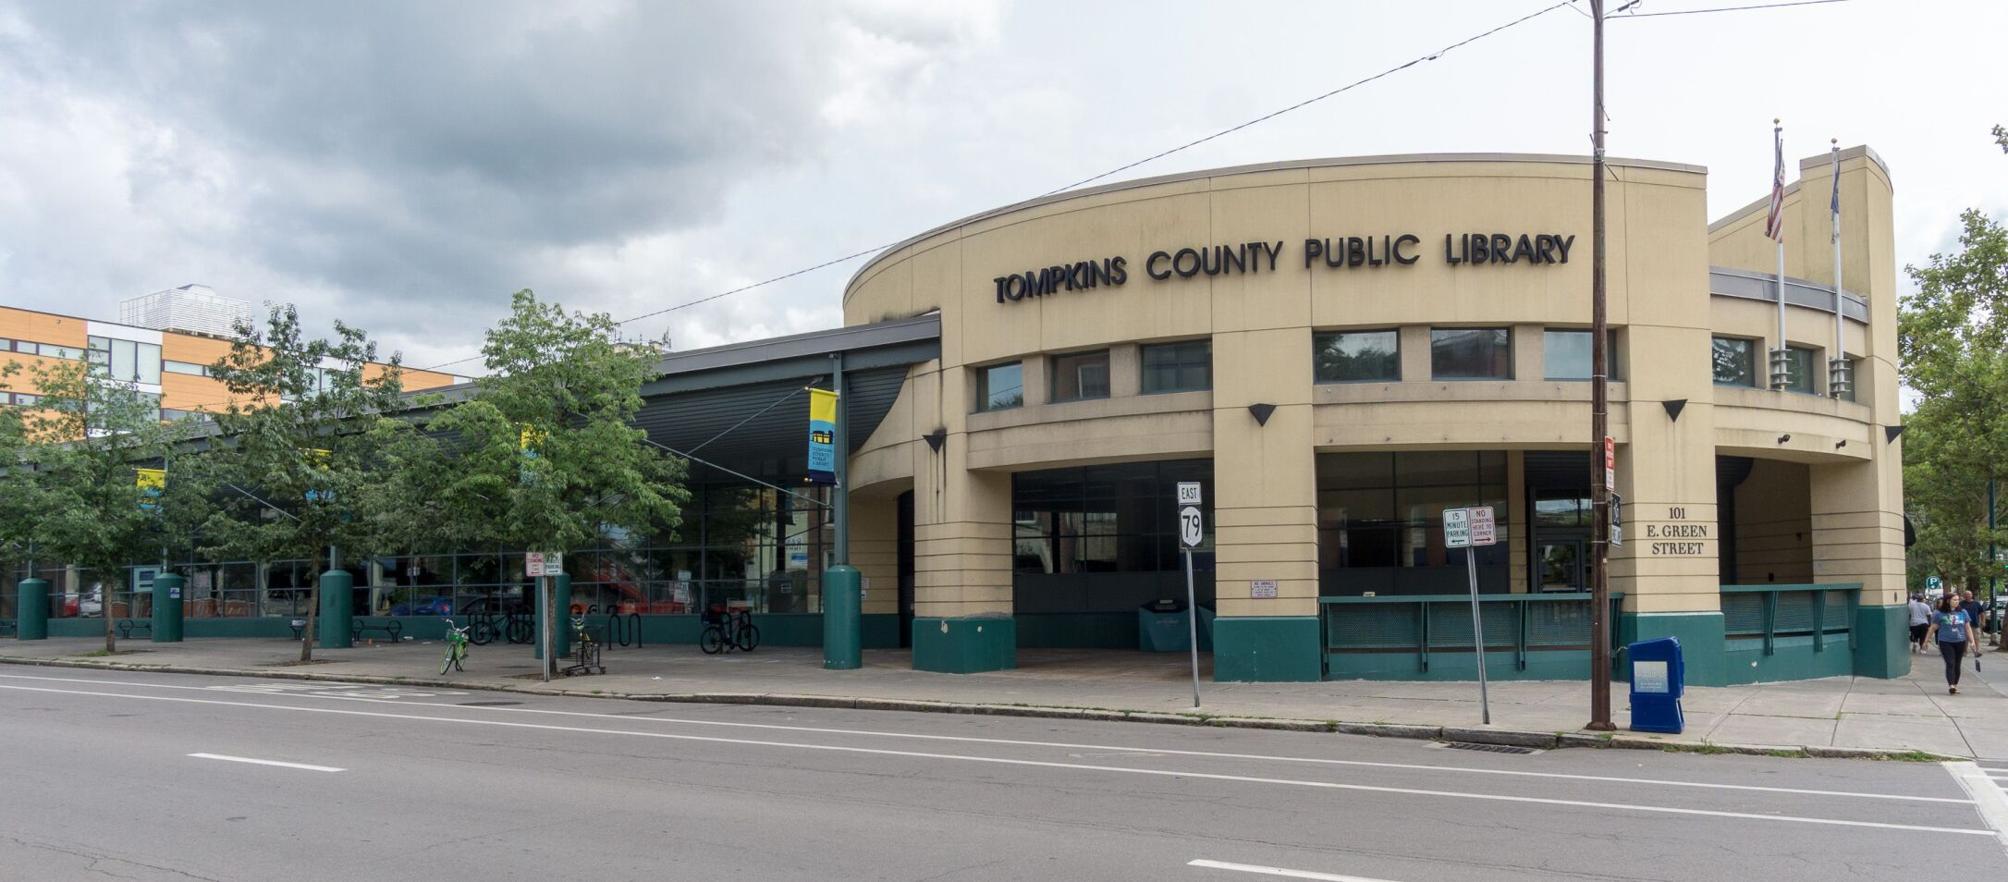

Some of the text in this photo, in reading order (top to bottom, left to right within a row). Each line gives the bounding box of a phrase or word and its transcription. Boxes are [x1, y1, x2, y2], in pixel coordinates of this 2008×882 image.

[993, 233, 1576, 304] TOMPKINS COUNTY PUBLIC LIBRARY
[1181, 487, 1197, 500] EAST
[1669, 507, 1686, 519] 101
[1182, 514, 1200, 538] 79
[1447, 521, 1467, 529] MINUTE
[1647, 525, 1707, 537] E. GREEN
[1447, 529, 1469, 538] PARKING
[1652, 542, 1704, 555] STREET
